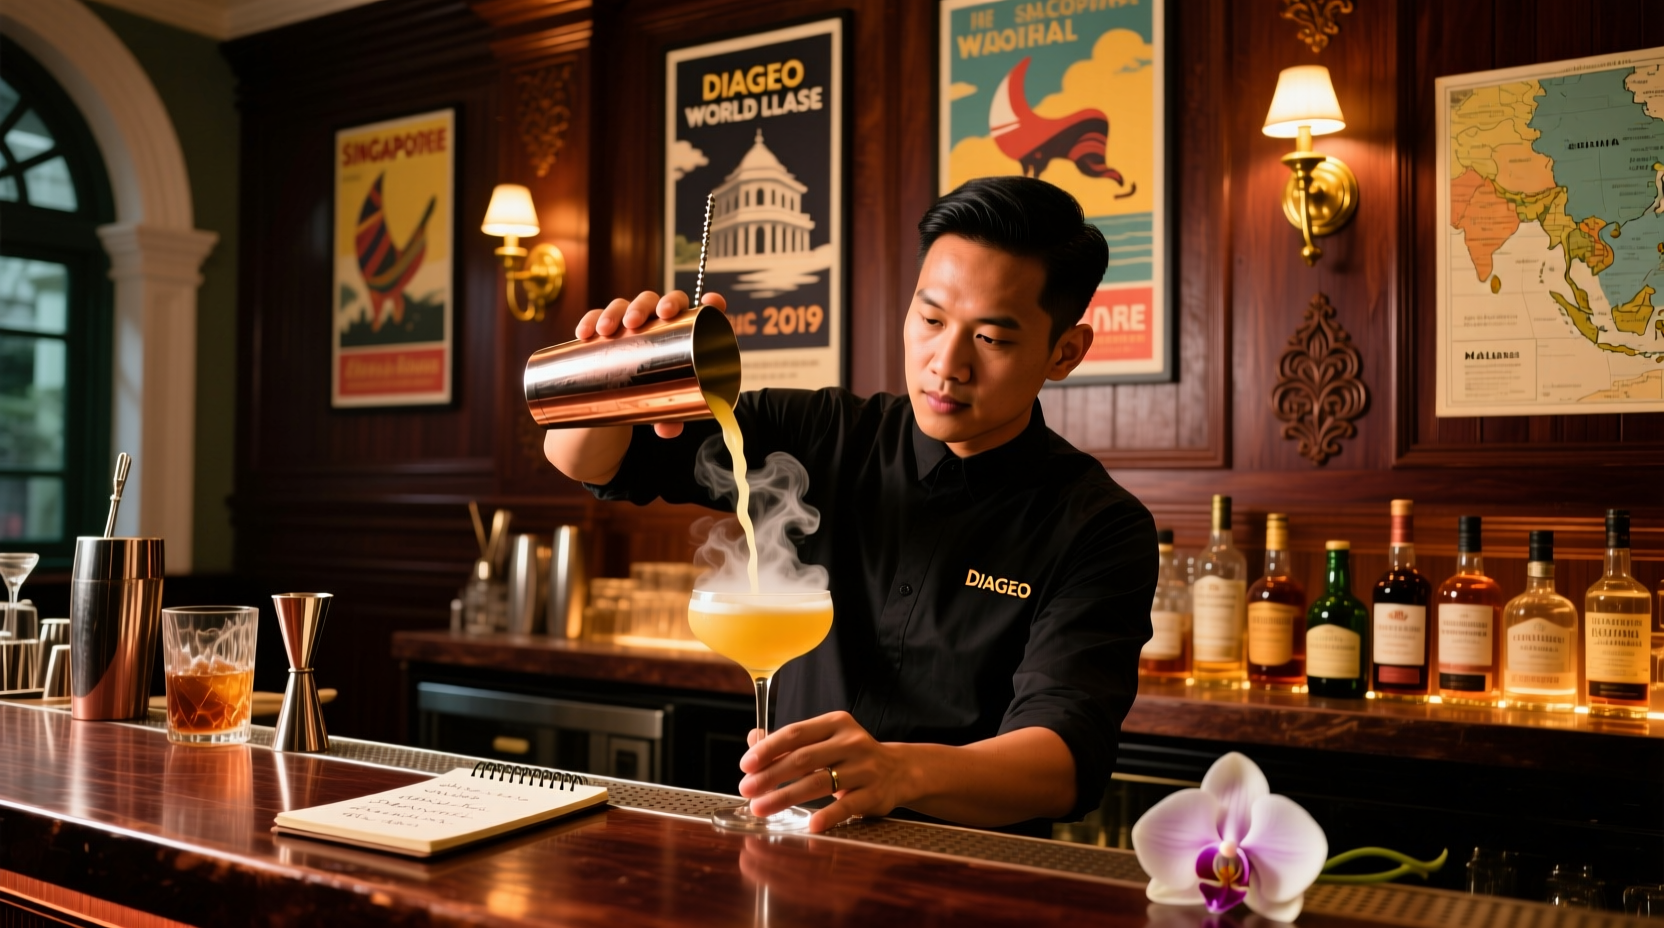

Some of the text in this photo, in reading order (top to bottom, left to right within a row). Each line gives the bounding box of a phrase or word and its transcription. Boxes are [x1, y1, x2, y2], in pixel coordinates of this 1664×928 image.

[702, 59, 805, 102] DIAGEO
[684, 86, 823, 128] WORLD LLASE
[761, 304, 824, 336] 2019
[965, 568, 1032, 599] DIAGEO
